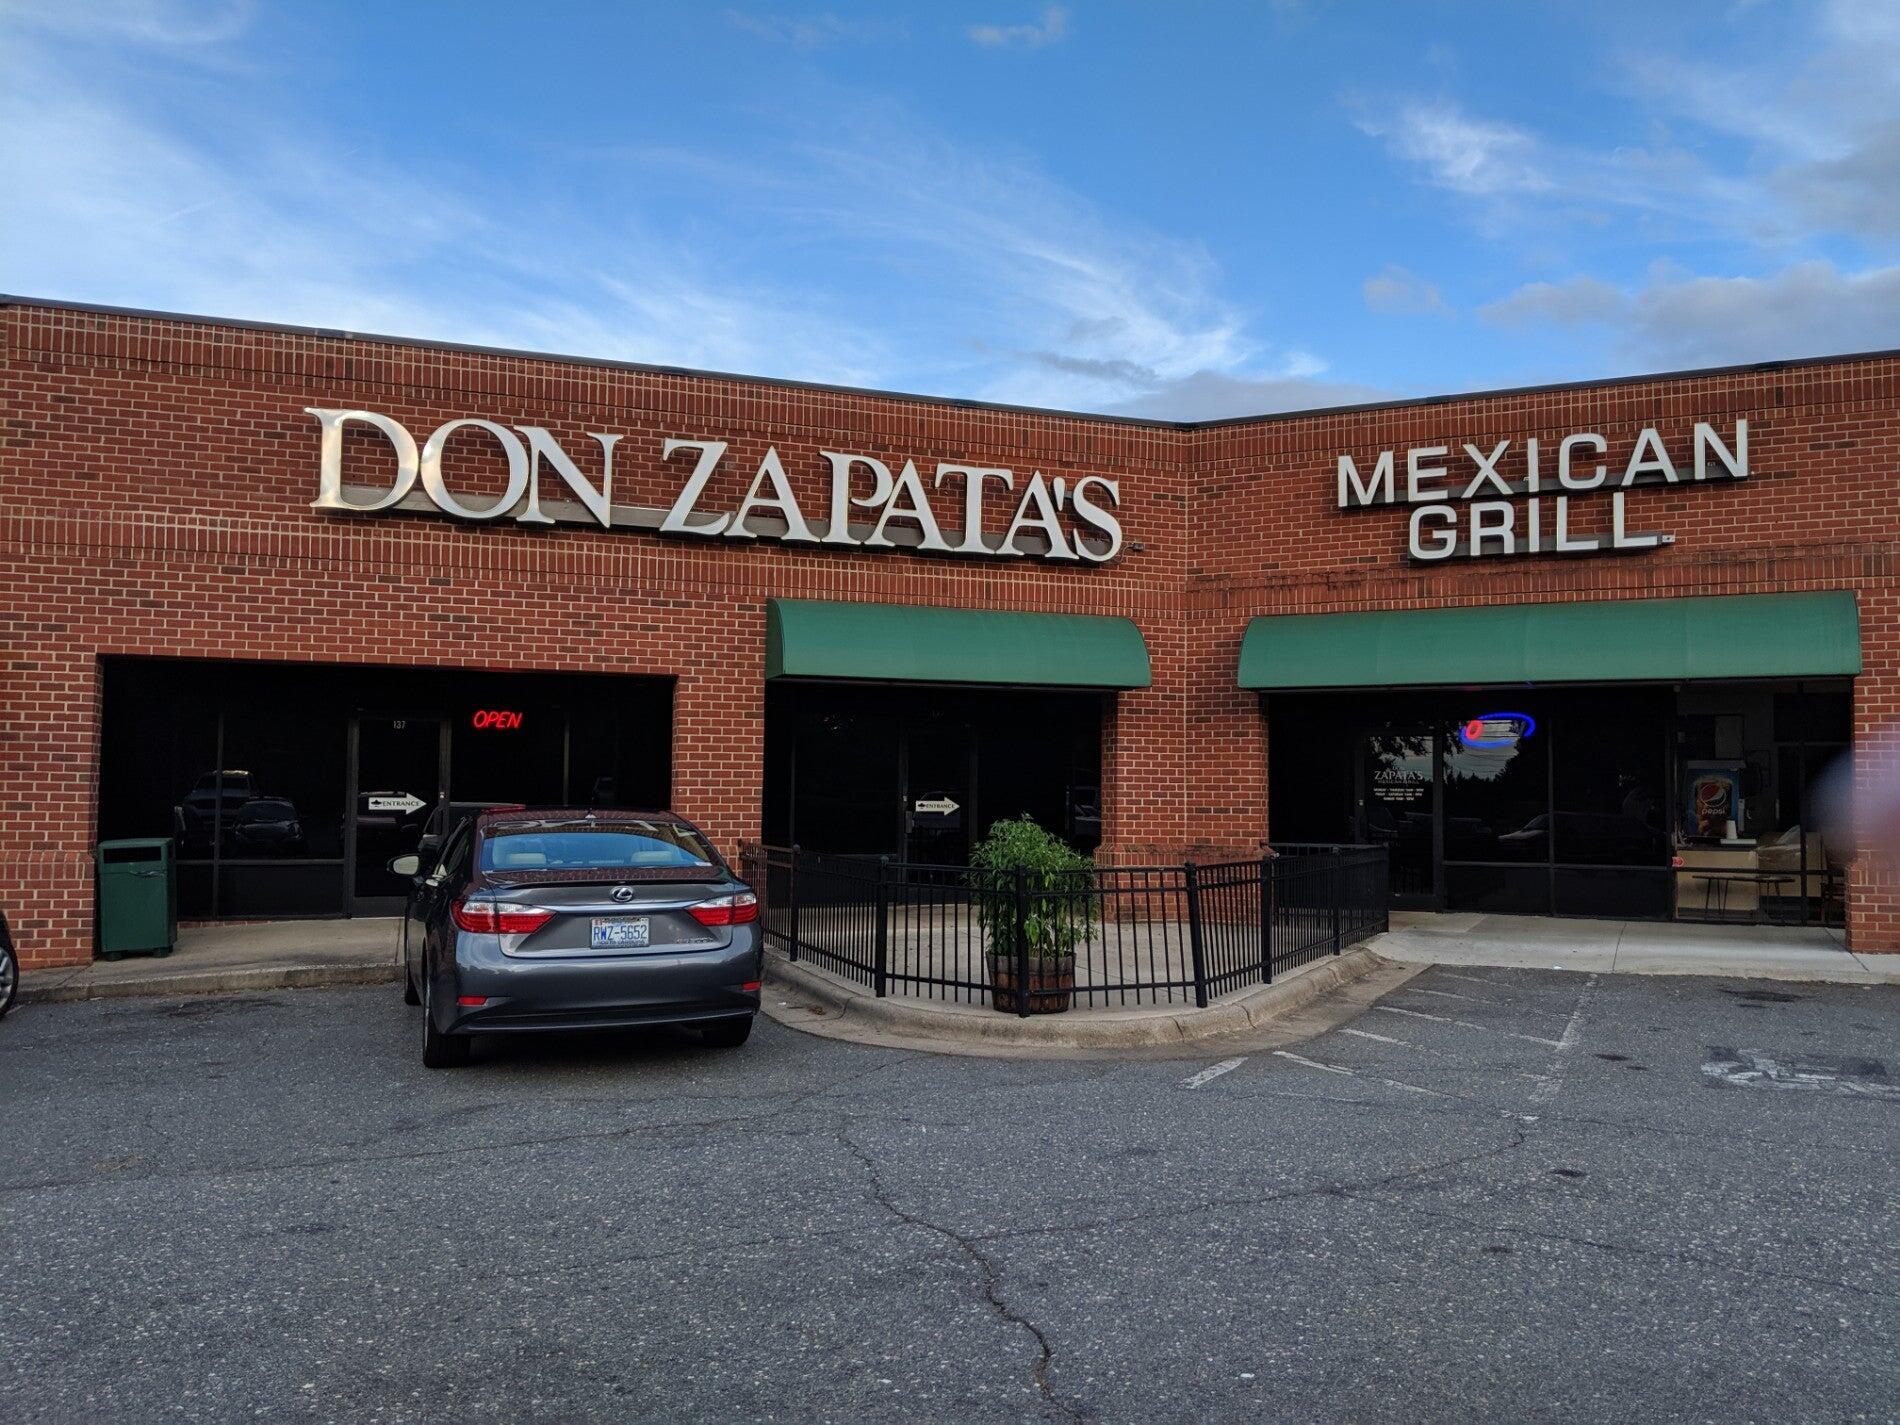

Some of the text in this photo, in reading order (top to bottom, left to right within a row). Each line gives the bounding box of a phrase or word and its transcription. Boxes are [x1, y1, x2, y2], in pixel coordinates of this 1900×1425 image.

[1337, 418, 1749, 508] MEXICAN
[304, 407, 1123, 562] DON ZAPATA'S
[1408, 491, 1658, 560] GRILL
[393, 720, 406, 729] 137
[473, 710, 523, 729] OPEN
[1374, 770, 1424, 781] ZAPATA'S
[1701, 807, 1725, 815] pepsi
[593, 924, 648, 941] RWZ-5652
